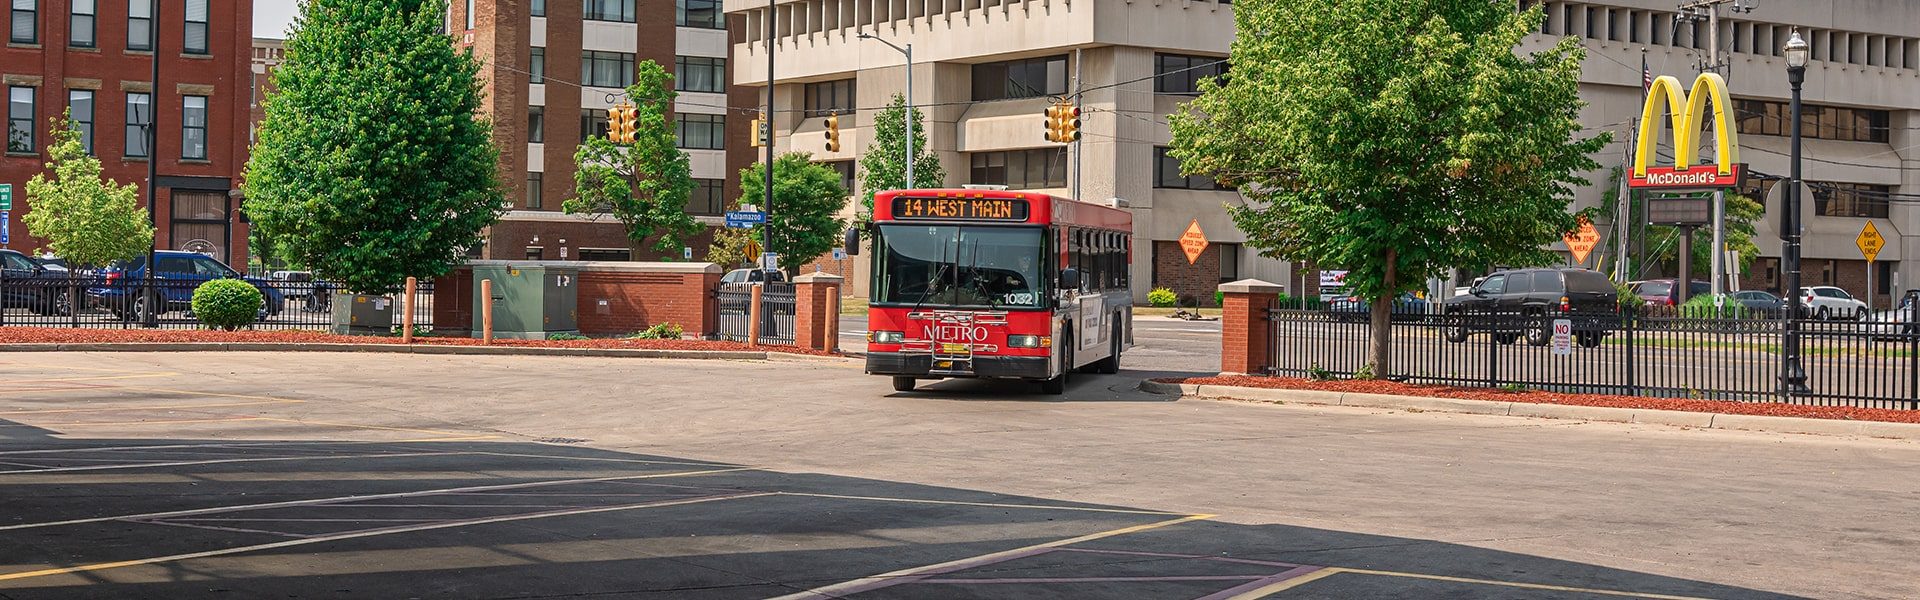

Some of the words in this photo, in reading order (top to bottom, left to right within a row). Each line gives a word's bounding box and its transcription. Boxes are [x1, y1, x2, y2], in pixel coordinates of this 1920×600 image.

[1646, 171, 1716, 184] McDonald's
[905, 199, 922, 216] 14
[927, 200, 967, 217] WEST
[972, 200, 1011, 218] MAIN
[730, 211, 762, 221] Kalamazoo
[1003, 292, 1033, 305] 1032
[924, 325, 988, 341] METRO
[1555, 324, 1569, 335] NO
